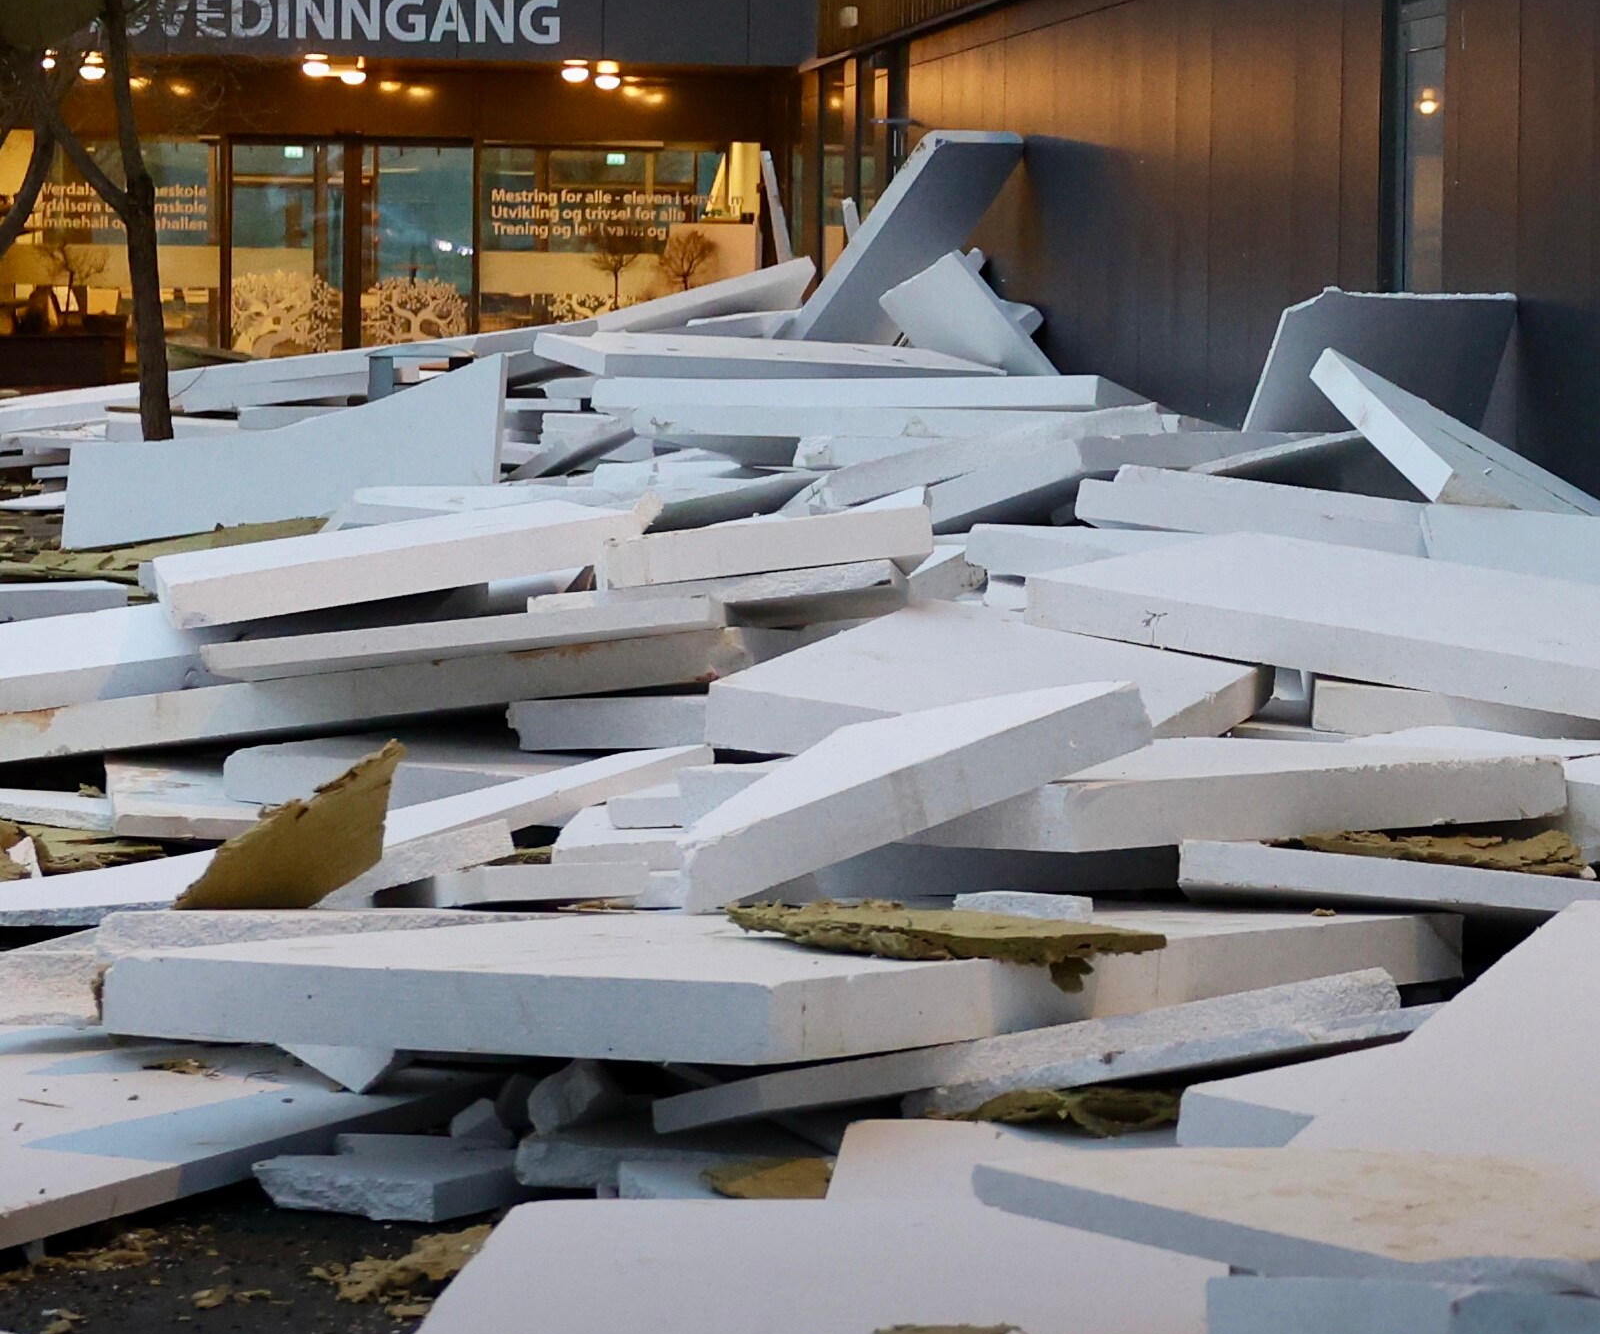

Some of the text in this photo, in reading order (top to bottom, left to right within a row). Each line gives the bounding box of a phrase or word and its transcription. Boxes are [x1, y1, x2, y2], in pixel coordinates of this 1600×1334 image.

[491, 188, 558, 207] Mestring
[561, 189, 583, 204] for
[585, 189, 612, 204] alle
[623, 190, 672, 205] eleven
[491, 205, 686, 223] Utvikling og trivsel for alle
[492, 222, 549, 239] Trening
[552, 225, 572, 240] og
[647, 227, 667, 241] og
